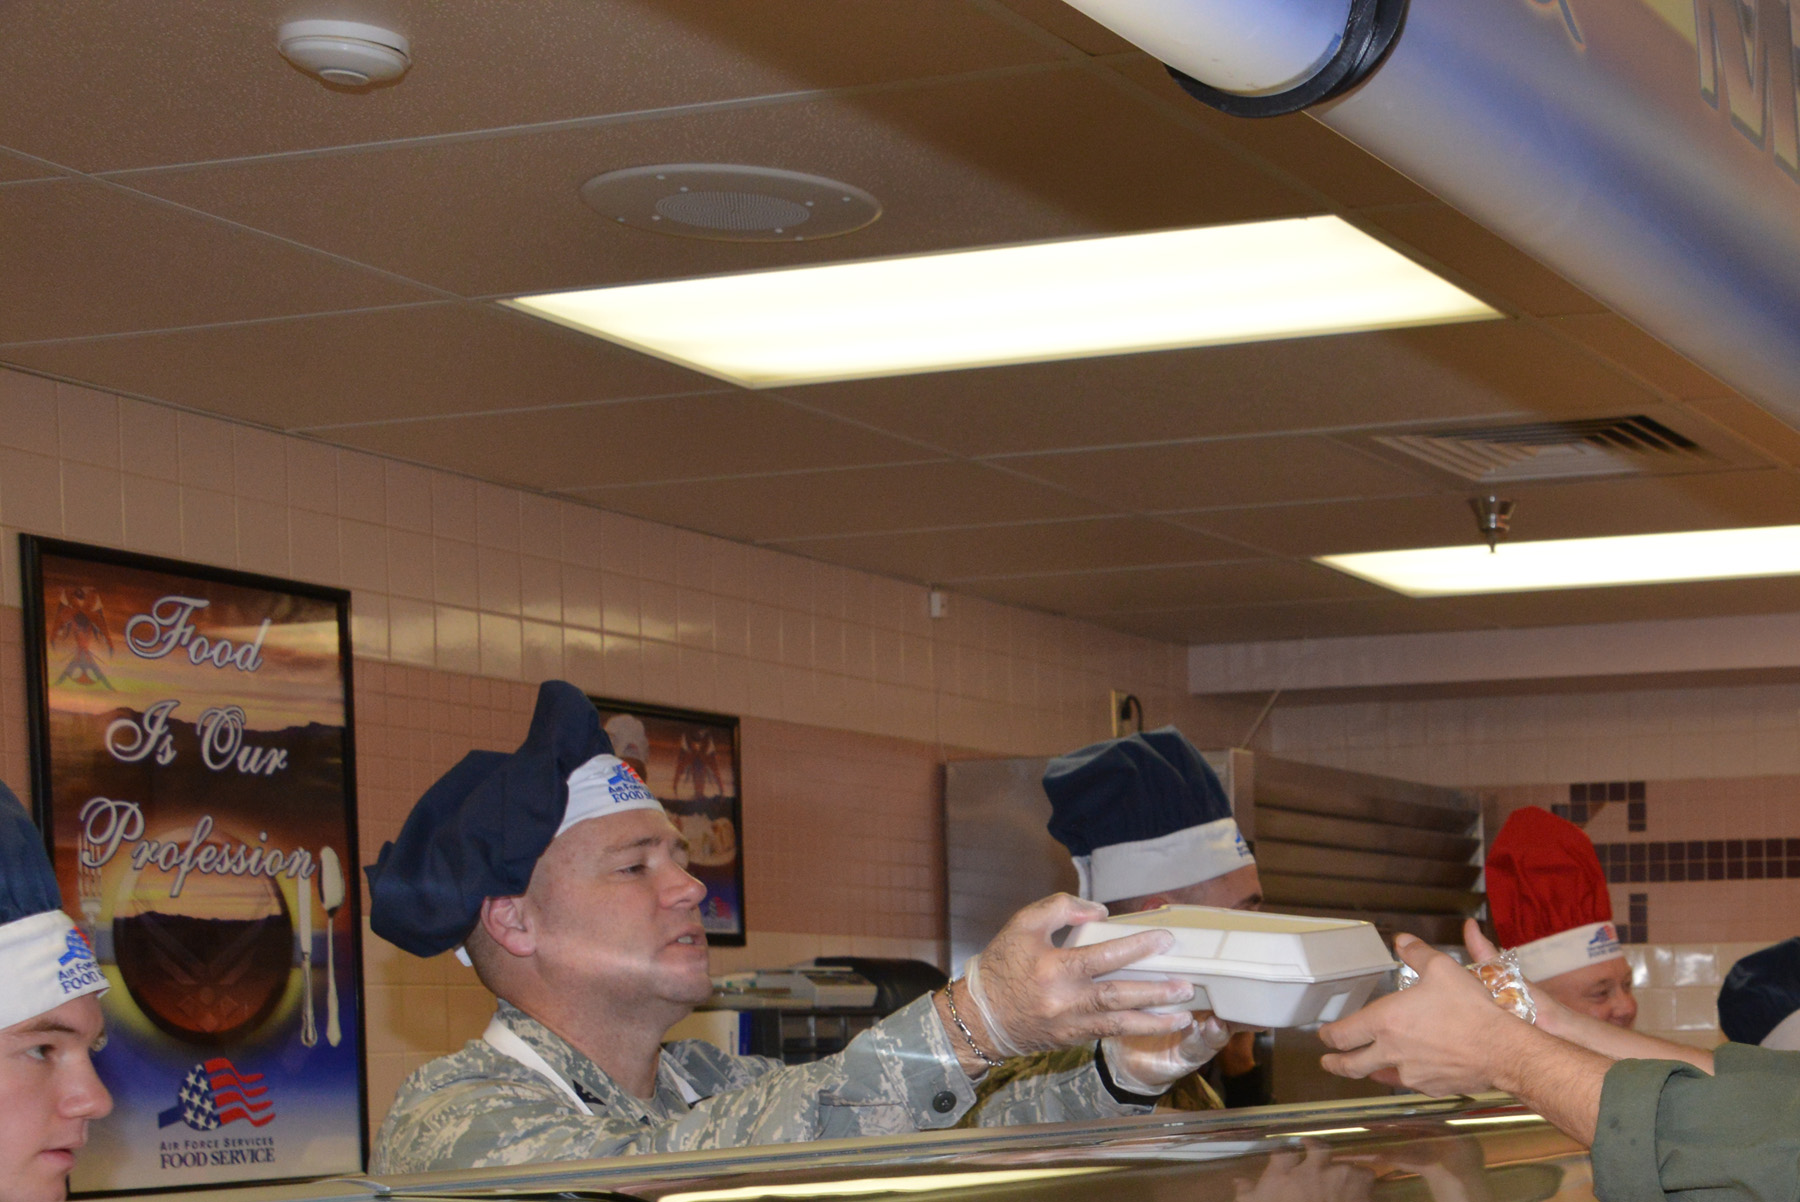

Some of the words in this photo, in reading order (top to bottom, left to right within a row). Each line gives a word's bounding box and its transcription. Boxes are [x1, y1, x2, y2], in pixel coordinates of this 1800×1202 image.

[125, 595, 272, 672] Food
[105, 699, 180, 765] Is
[196, 704, 288, 774] Our
[611, 790, 644, 804] FOOD
[79, 796, 316, 898] Profession
[60, 971, 99, 994] FOOD
[160, 1141, 179, 1151] AIR
[184, 1140, 219, 1149] FORCE
[224, 1137, 274, 1148] SERVICES
[160, 1151, 208, 1169] FOOD
[210, 1147, 275, 1166] SERVICE
